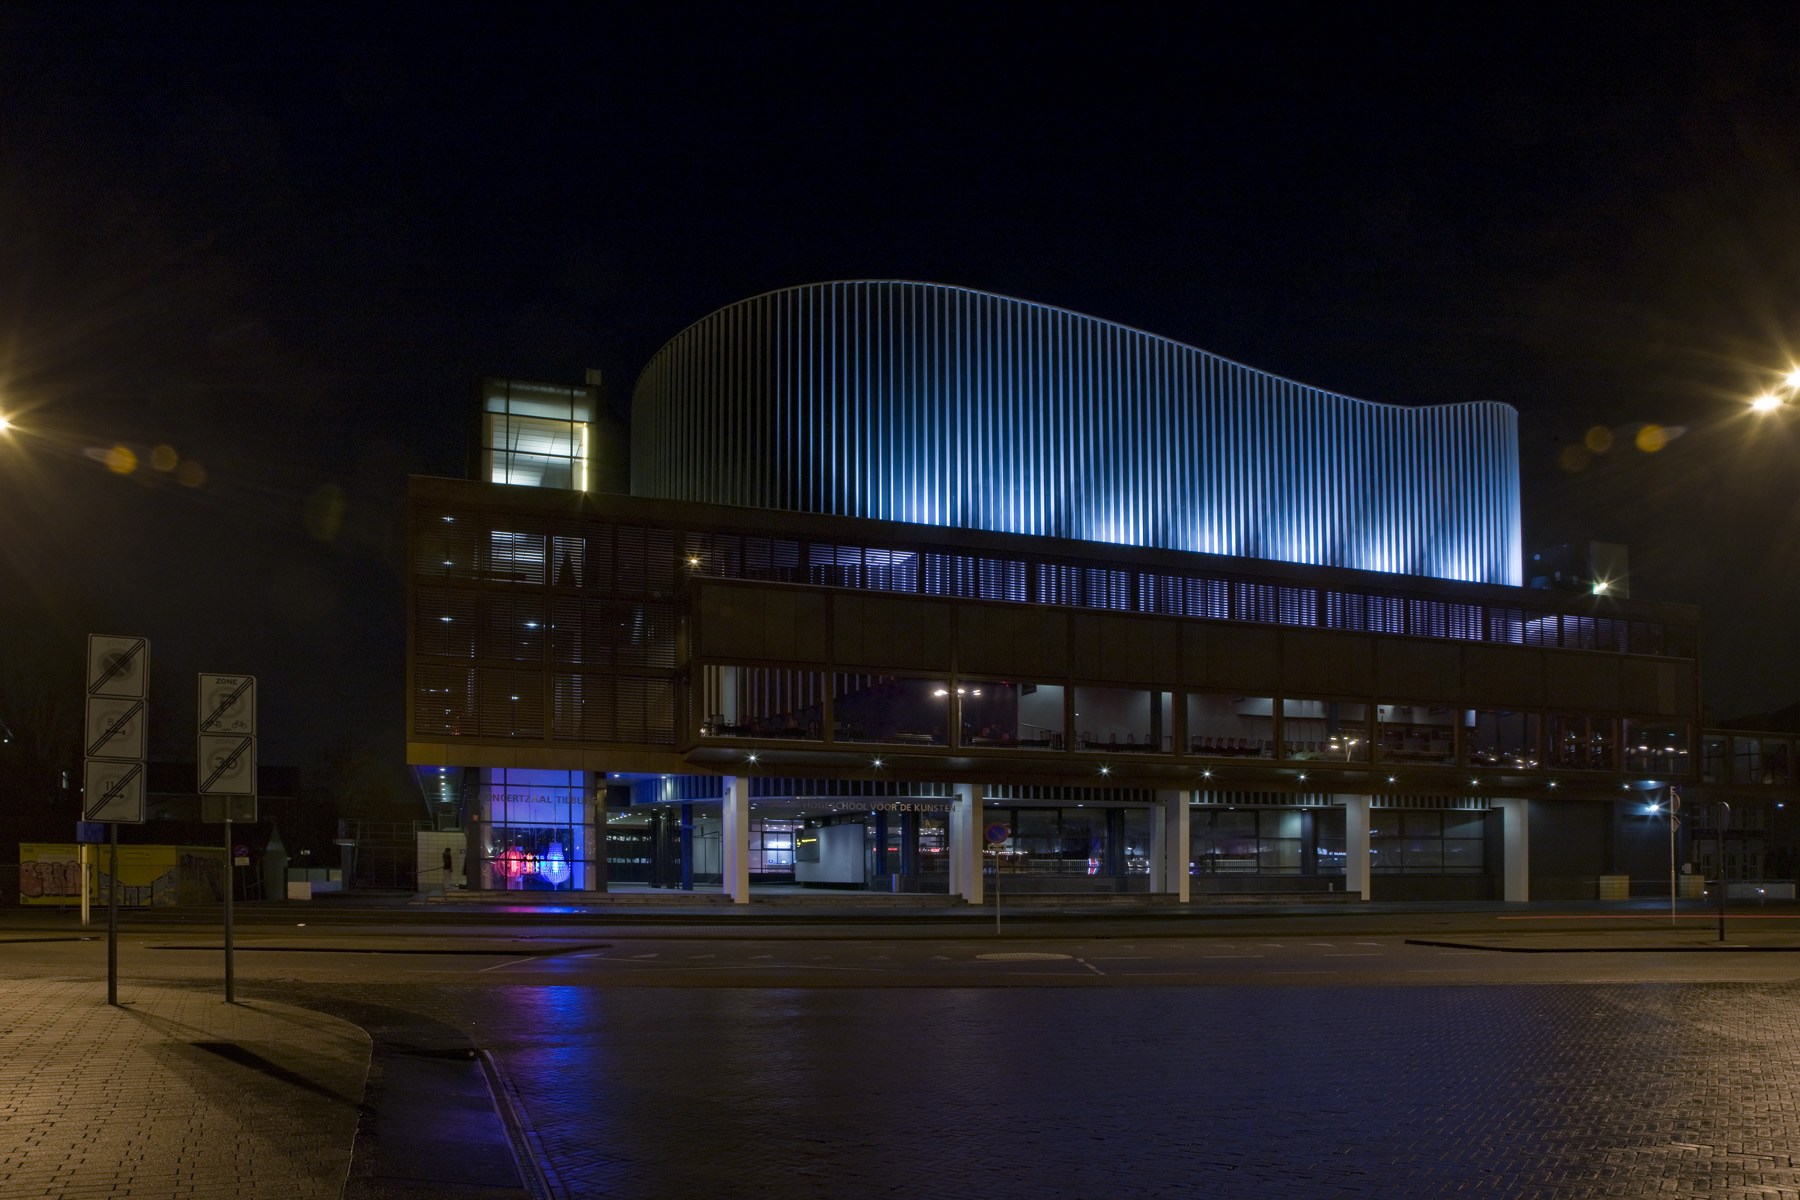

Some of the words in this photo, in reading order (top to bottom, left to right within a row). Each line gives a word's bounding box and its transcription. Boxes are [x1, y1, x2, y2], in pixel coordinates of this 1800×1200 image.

[107, 717, 114, 727] 8
[803, 801, 867, 811] HOGESCHOOL
[870, 802, 897, 811] VOOR
[900, 804, 911, 812] DE
[914, 804, 956, 812] KUNSTEN
